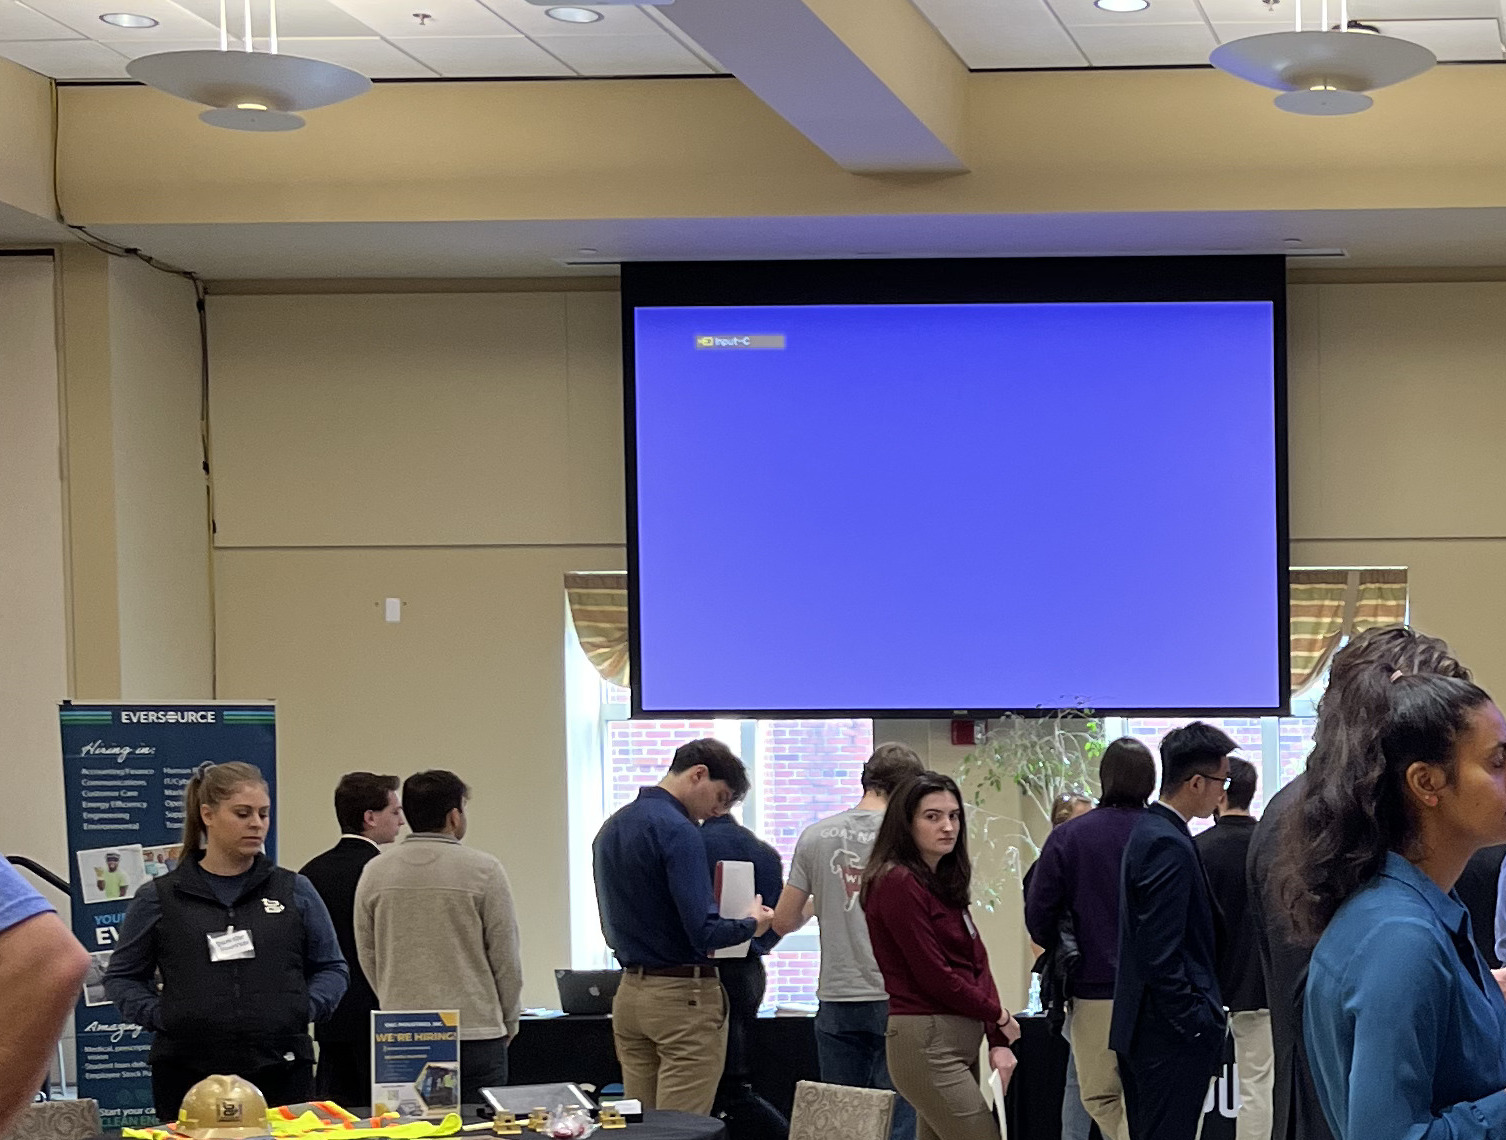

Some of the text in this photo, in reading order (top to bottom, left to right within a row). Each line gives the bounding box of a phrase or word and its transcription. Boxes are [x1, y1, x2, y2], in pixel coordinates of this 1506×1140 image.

[121, 711, 216, 724] EVERSOURCE
[81, 740, 156, 763] Hiring in:
[376, 1032, 413, 1043] WE'RE
[122, 1107, 144, 1116] your
